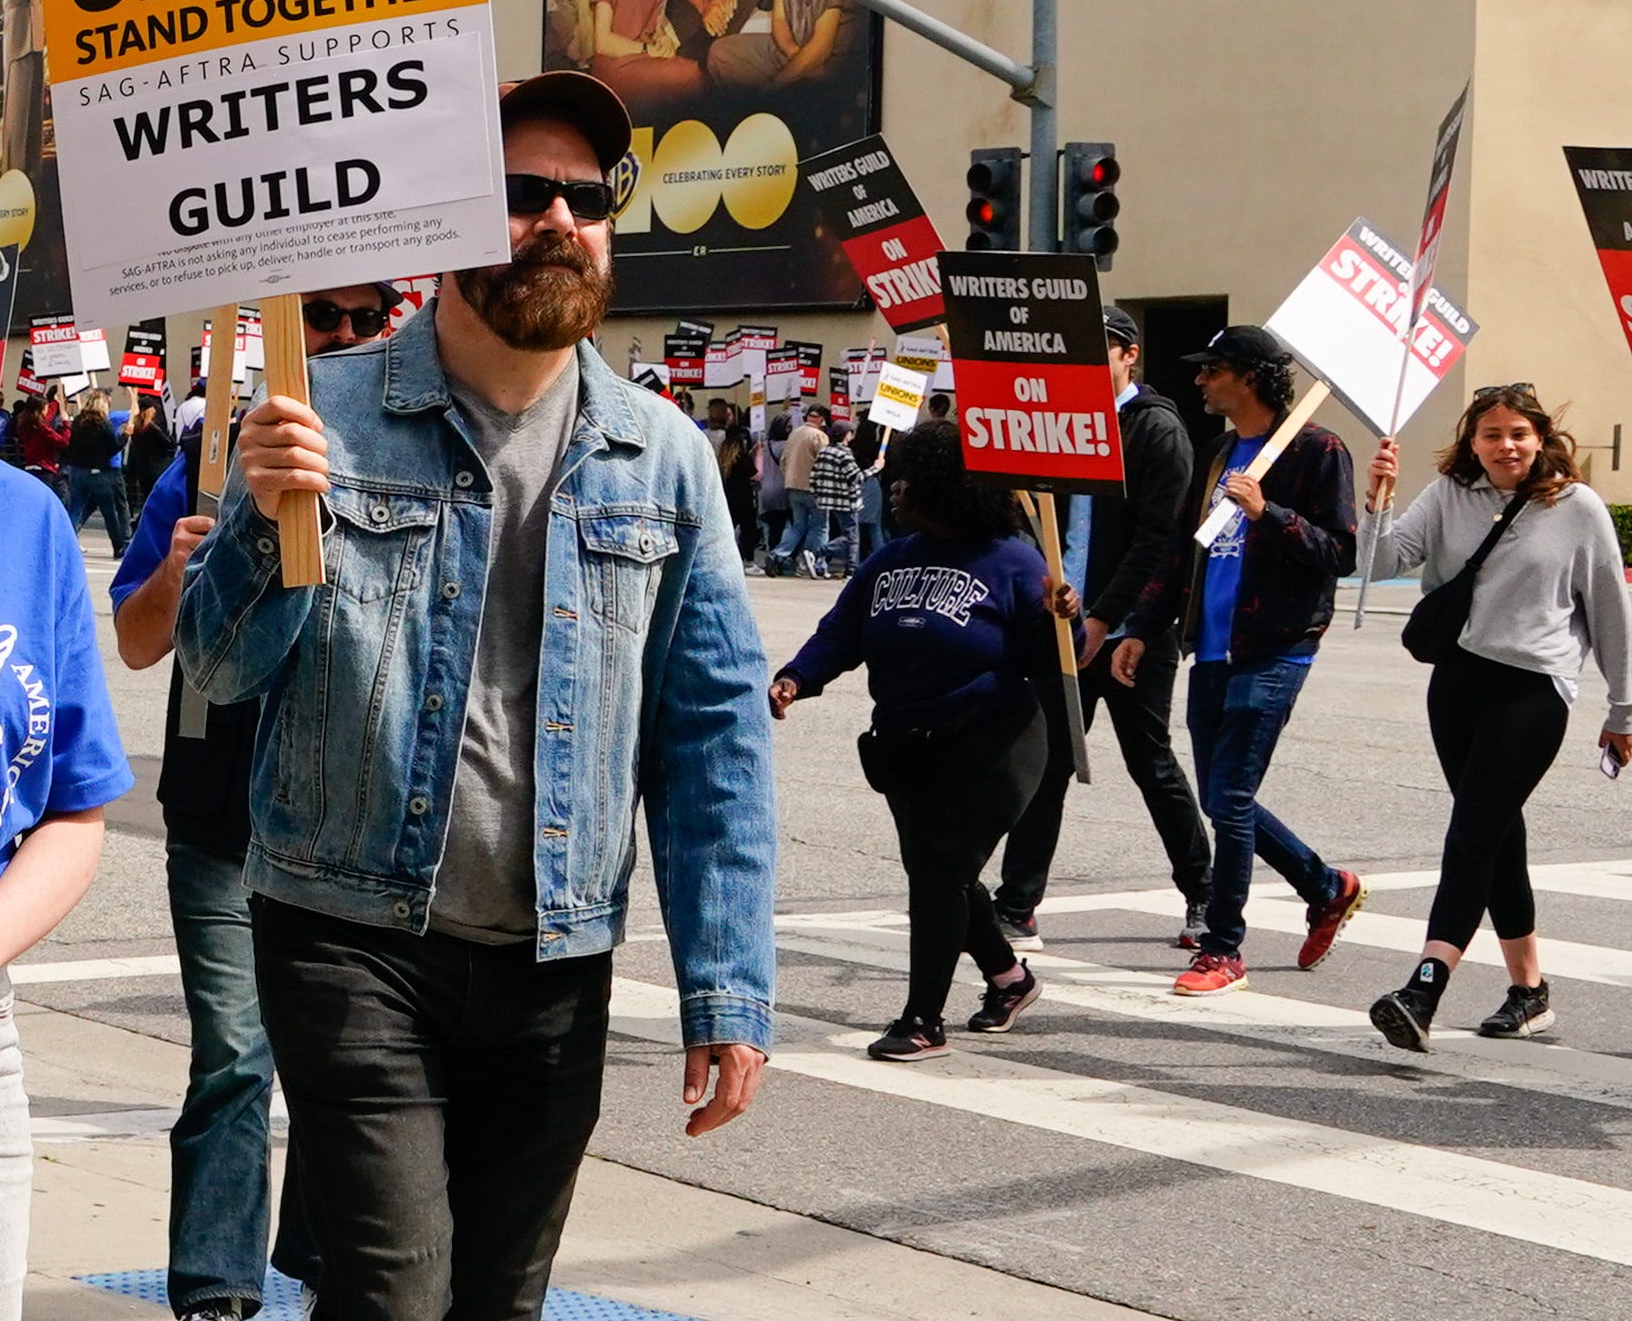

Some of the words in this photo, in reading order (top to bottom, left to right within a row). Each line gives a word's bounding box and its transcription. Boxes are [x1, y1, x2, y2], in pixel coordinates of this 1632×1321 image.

[76, 5, 208, 66] STAND
[80, 52, 257, 107] SAG-AFTRA
[278, 18, 460, 66] SUPPORTS
[113, 60, 428, 163] WRITERS
[663, 169, 723, 184] CELEBRATING
[725, 167, 754, 180] EVERY
[756, 164, 787, 178] STORY
[807, 161, 858, 192] WRITERS
[854, 150, 891, 176] GUILD
[1578, 169, 1632, 190] WRITE
[168, 158, 381, 238] GUILD
[852, 184, 868, 200] OF
[847, 198, 900, 228] AMERICA
[108, 280, 149, 296] services,
[149, 279, 160, 288] or
[161, 276, 172, 285] to
[173, 270, 203, 283] refuse
[205, 268, 216, 277] to
[216, 263, 237, 276] pick
[296, 246, 333, 262] handle
[335, 246, 347, 256] or
[349, 236, 400, 256] transport
[401, 234, 423, 249] any
[424, 229, 461, 245] goods.
[122, 260, 176, 279] SAG-AFTRA
[178, 258, 186, 267] is
[187, 255, 204, 266] not
[206, 249, 238, 264] asking
[239, 247, 256, 258] any
[259, 235, 311, 253] individual
[313, 234, 325, 244] to
[326, 230, 357, 243] cease
[358, 219, 421, 242] performing
[422, 217, 443, 231] any
[881, 237, 908, 261] ON
[867, 256, 943, 309] STRIK
[949, 275, 1029, 299] WRITERS
[1031, 279, 1088, 300] GUILD
[1359, 226, 1414, 279] WRITE
[1428, 287, 1470, 334] GUILD
[1009, 306, 1029, 324] OF
[33, 327, 77, 344] STRIKE!
[984, 330, 1067, 354] AMERICA
[896, 357, 936, 368] UNIONS
[880, 382, 919, 403] UNIONS
[1013, 377, 1048, 403] ON
[965, 407, 1110, 457] STRIKE!
[871, 566, 990, 627] CULTURE
[10, 663, 51, 793] AMERIC
